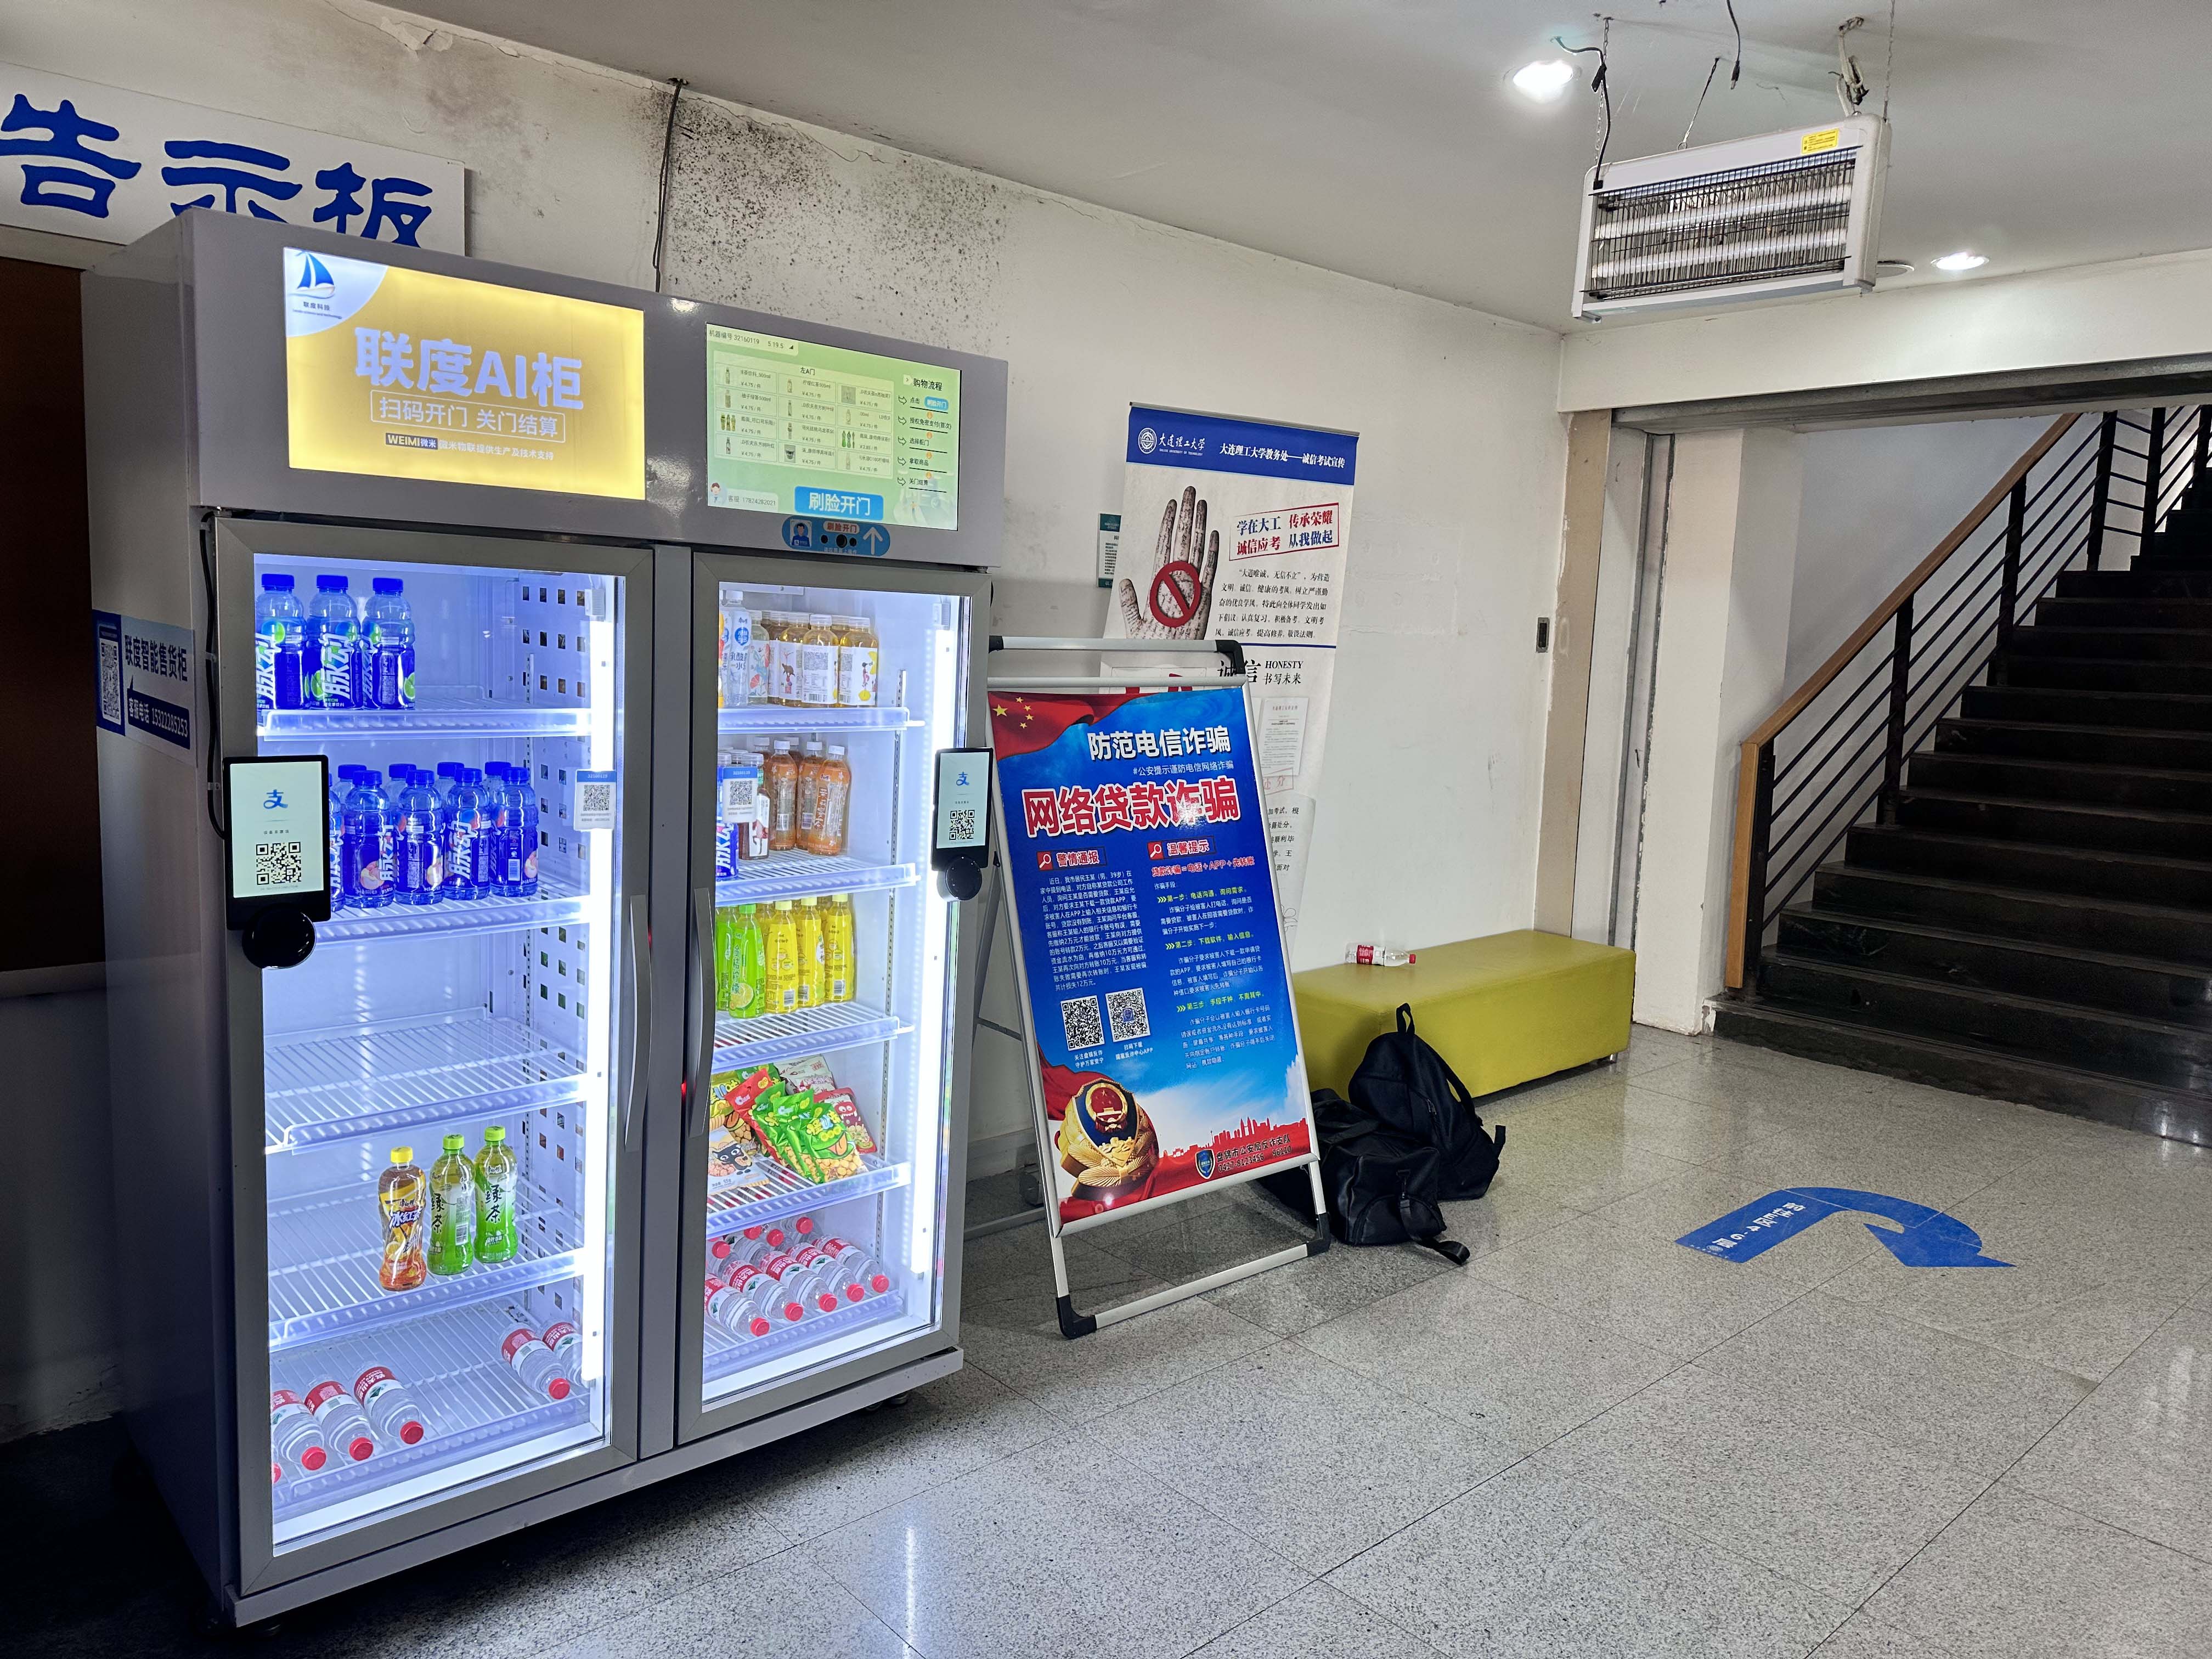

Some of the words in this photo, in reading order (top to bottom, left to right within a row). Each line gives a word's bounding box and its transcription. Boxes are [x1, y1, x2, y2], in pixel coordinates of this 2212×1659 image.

[0, 94, 432, 248] 告示板
[709, 329, 732, 339] 机器编号
[733, 335, 760, 345] 32160119
[355, 326, 584, 410] 联度AI柜
[800, 366, 815, 376] 左A门
[913, 379, 943, 391] 购物流程
[380, 397, 467, 427] 扫码开门
[477, 409, 558, 438] 关门结算
[1158, 432, 1205, 451] 大连理工大学
[809, 492, 871, 516] 刷脸开门
[827, 522, 857, 533] 刷脸开门
[1237, 516, 1282, 535] 学在大工
[1289, 510, 1333, 529] 传承荣耀
[1237, 536, 1281, 556] 诚信应考
[1289, 529, 1333, 548] 从我做起
[124, 634, 188, 682] 联度智能售货柜
[1265, 660, 1304, 669] HONESTY
[1262, 673, 1301, 685] 书写未来
[129, 697, 149, 725] 客服电话
[151, 707, 188, 738] 15322285253
[1087, 725, 1232, 761] 防范电信诈骗
[1132, 760, 1234, 776] #公安提示谨防电信网络诈骗
[1021, 774, 1242, 840] 网络贷款诈骗
[1056, 849, 1100, 867] 警情通报
[1167, 838, 1210, 856] 温馨提示
[1124, 1041, 1143, 1051] 扫码下载
[1216, 1134, 1290, 1163] 盘锦市公安局反诈支队
[485, 1184, 503, 1224] 绿茶
